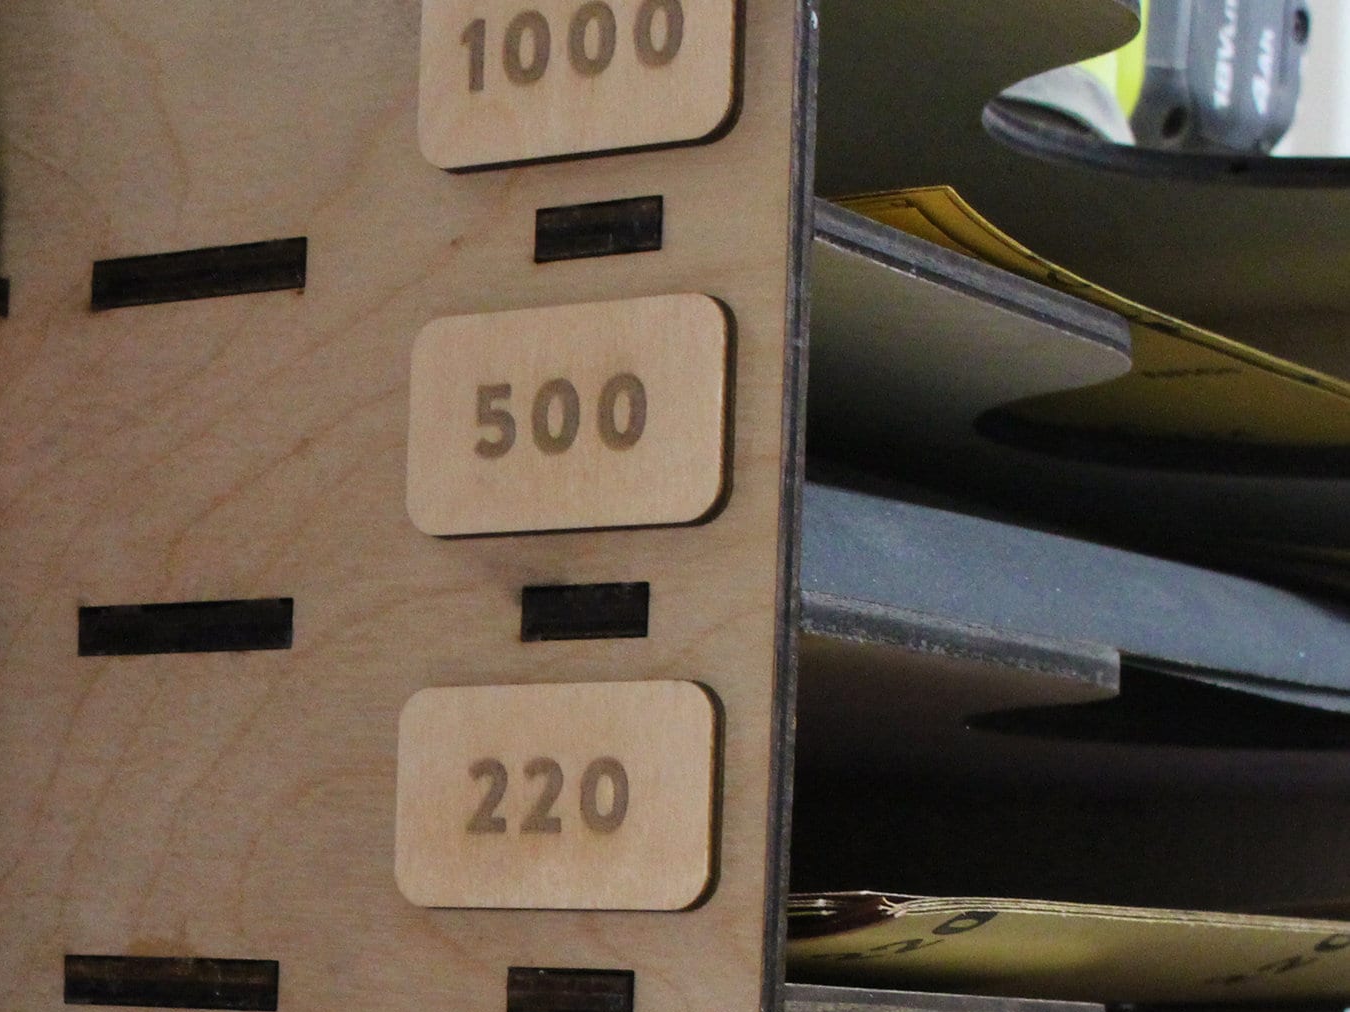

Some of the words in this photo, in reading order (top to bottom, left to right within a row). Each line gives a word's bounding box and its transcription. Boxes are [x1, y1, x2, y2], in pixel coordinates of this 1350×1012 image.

[459, 0, 685, 93] 1000
[473, 372, 648, 460] 500
[465, 757, 630, 836] 220
